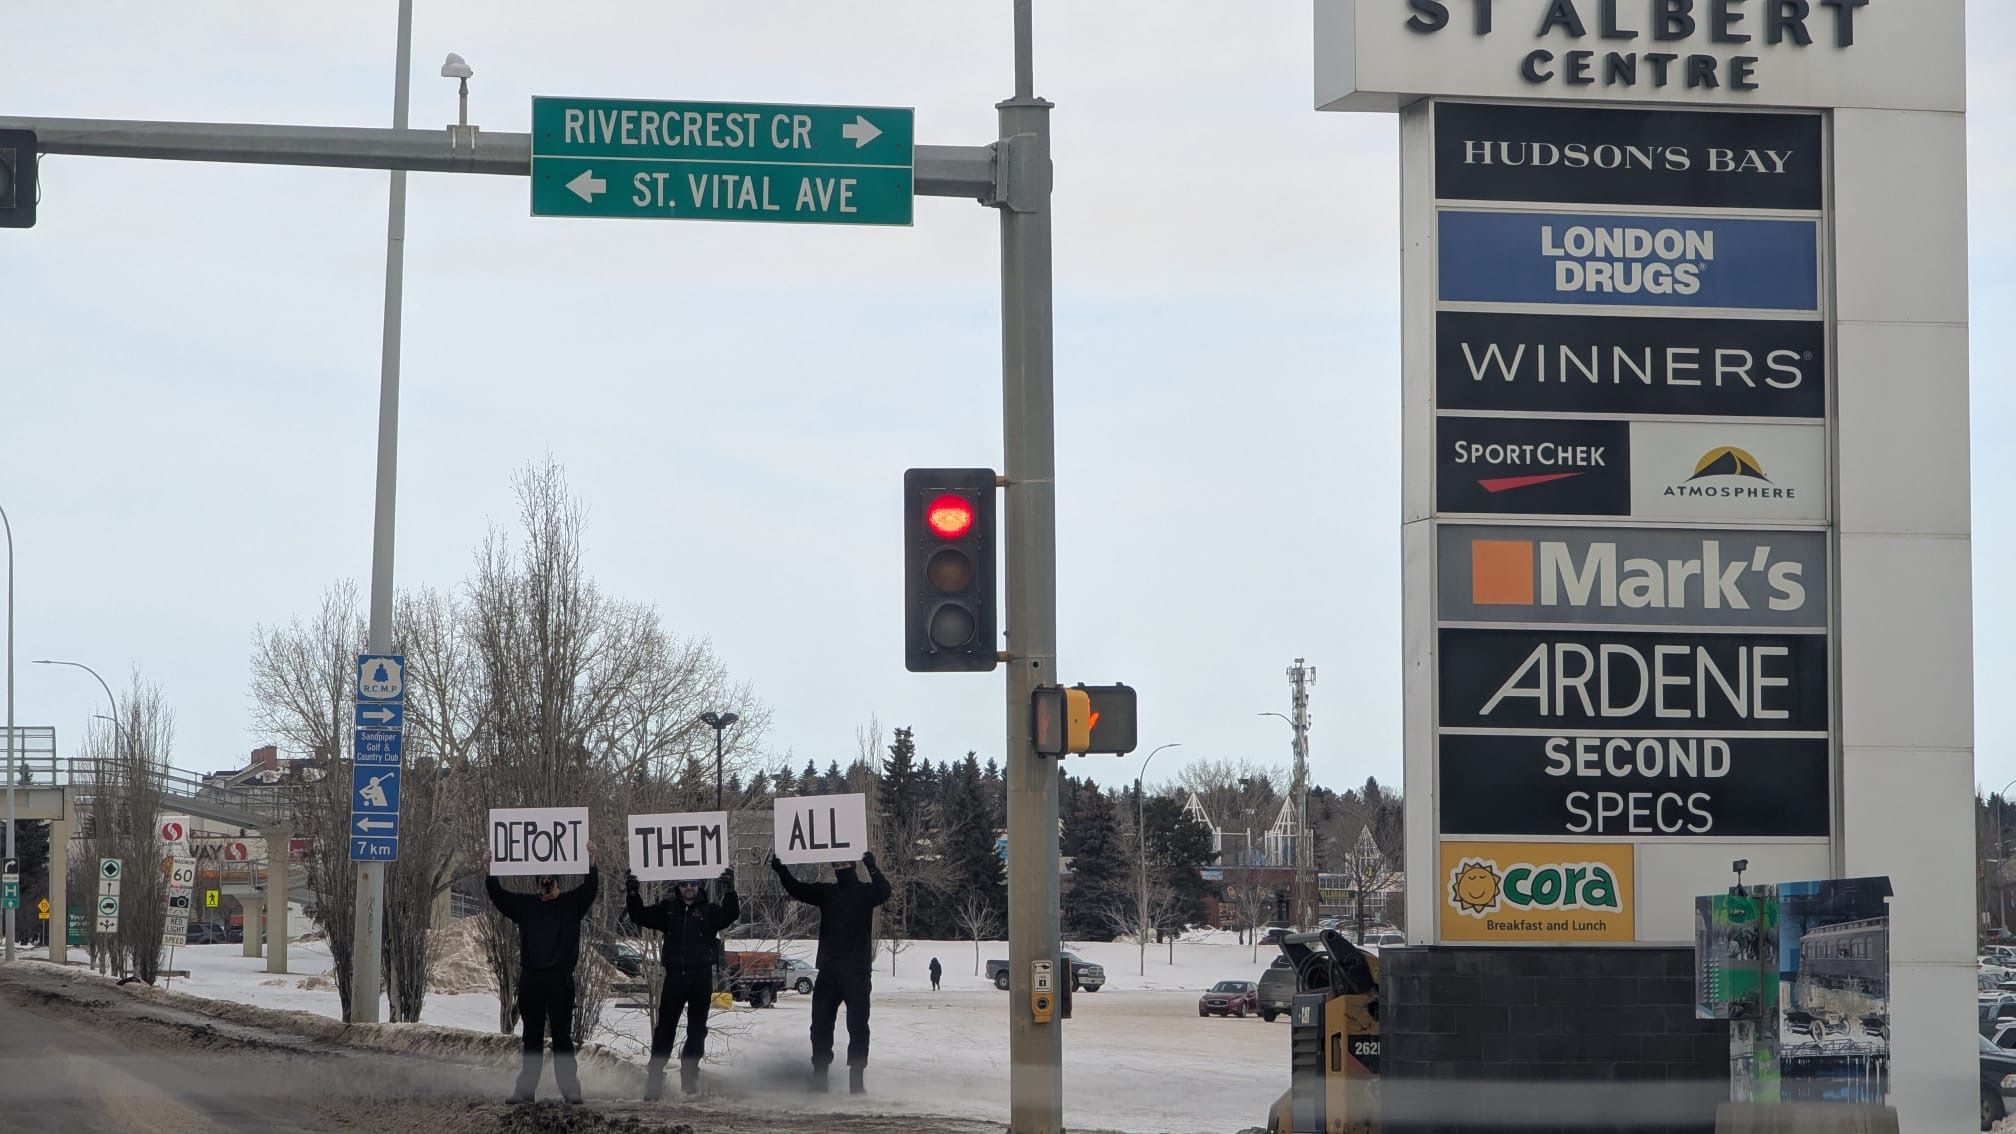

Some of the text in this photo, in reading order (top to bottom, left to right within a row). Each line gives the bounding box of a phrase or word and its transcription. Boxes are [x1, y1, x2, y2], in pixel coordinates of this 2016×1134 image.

[1406, 0, 1870, 48] ST ALBERT
[1521, 48, 1760, 90] CENTRE
[565, 107, 812, 149] RIVERCREST CR
[1463, 139, 1795, 174] HUDSON'S BAY
[632, 171, 858, 213] ST. VITAL AVE
[1541, 225, 1714, 261] LONDON
[1555, 260, 1701, 295] DRUGS
[1460, 342, 1803, 390] WINNERS
[1663, 485, 1795, 499] ATMOSPHERE
[1539, 539, 1806, 612] Mark's
[1478, 642, 1790, 719] ARDENE
[361, 731, 397, 744] Sandpiper
[366, 742, 390, 752] Golf &
[357, 752, 399, 763] Country Club
[1544, 736, 1731, 778] SECOND
[788, 807, 851, 851] ALL
[1565, 791, 1714, 834] SPECS
[357, 841, 391, 856] 7 km
[494, 820, 583, 863] DEPORT
[634, 824, 722, 868] THEM
[5, 885, 17, 897] H
[173, 868, 193, 883] 60
[1503, 865, 1618, 908] cora
[166, 926, 185, 934] LIGHT
[170, 918, 183, 926] RED
[1486, 919, 1607, 932] Breakfast and Lunch
[164, 936, 184, 945] SPEED
